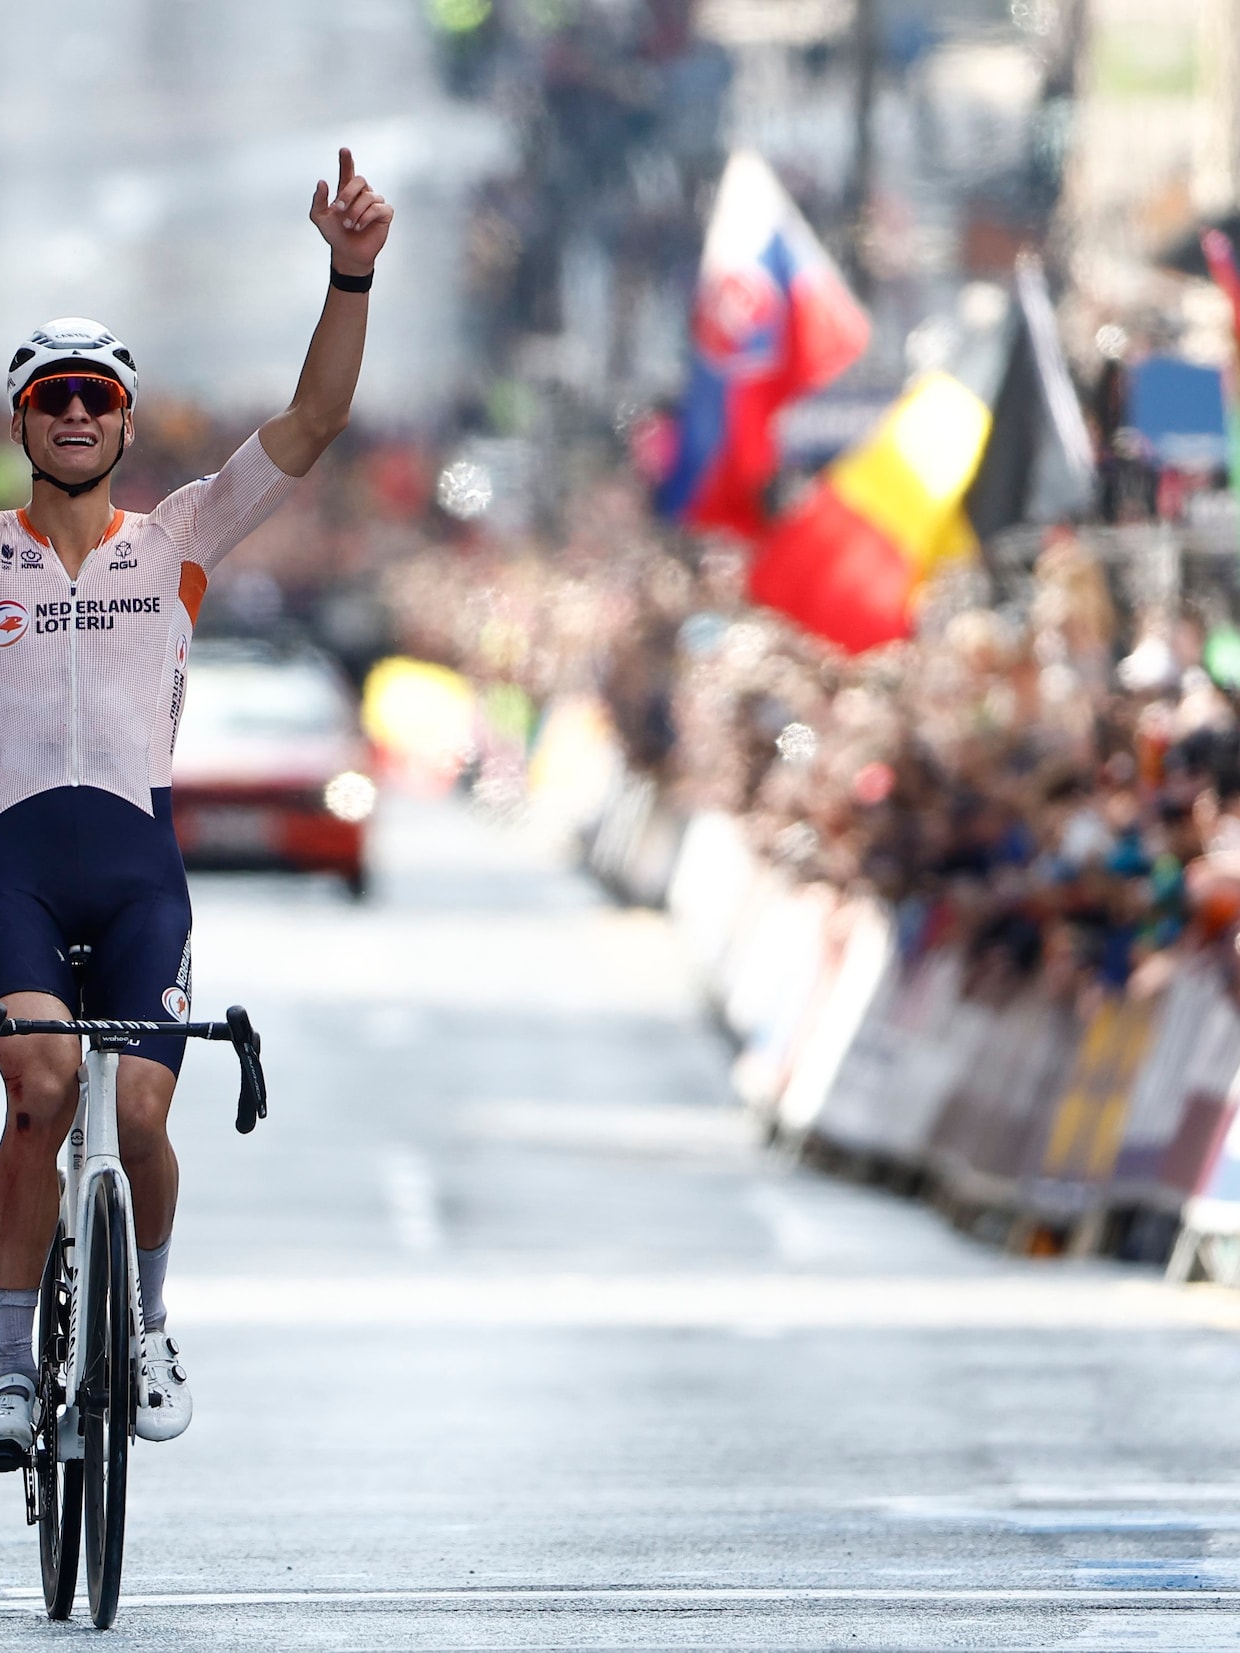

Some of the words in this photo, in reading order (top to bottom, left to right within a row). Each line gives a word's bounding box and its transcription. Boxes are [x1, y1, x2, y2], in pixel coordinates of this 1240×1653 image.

[110, 558, 138, 571] AGU
[36, 597, 160, 617] NEDERLANDSE
[36, 615, 114, 634] LOTERIJ
